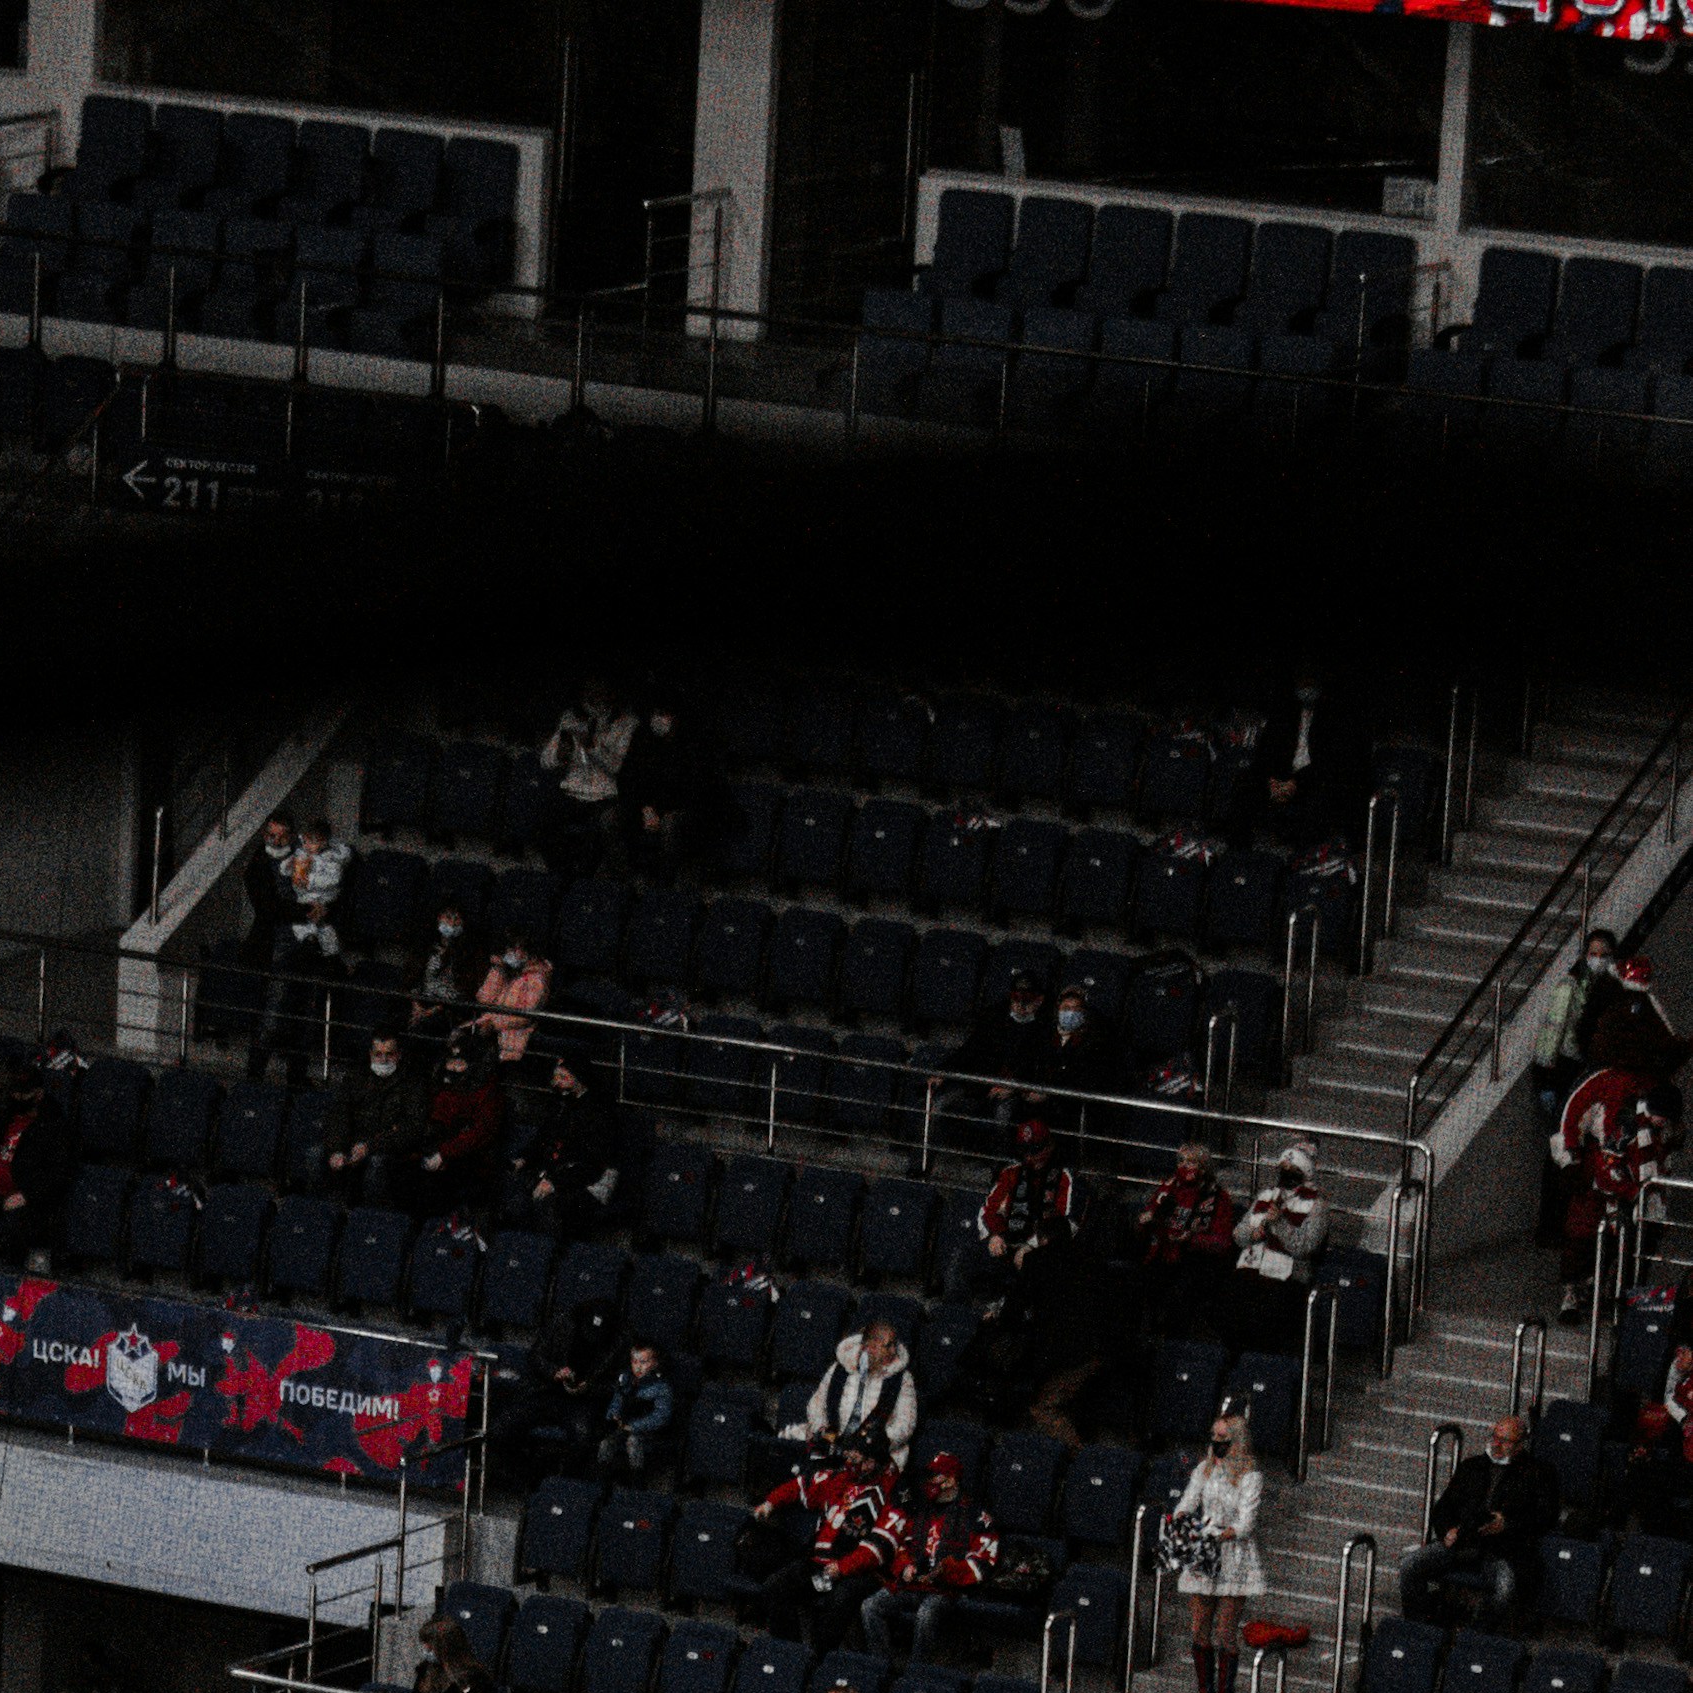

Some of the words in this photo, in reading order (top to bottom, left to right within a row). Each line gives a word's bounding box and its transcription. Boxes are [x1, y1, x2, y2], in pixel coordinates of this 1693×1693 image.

[162, 475, 219, 510] 211
[32, 1339, 100, 1369] ЦСКА!
[167, 1361, 206, 1388] МЫ
[279, 1380, 400, 1421] ПОБЕДИМ!
[978, 1535, 1000, 1559] 74
